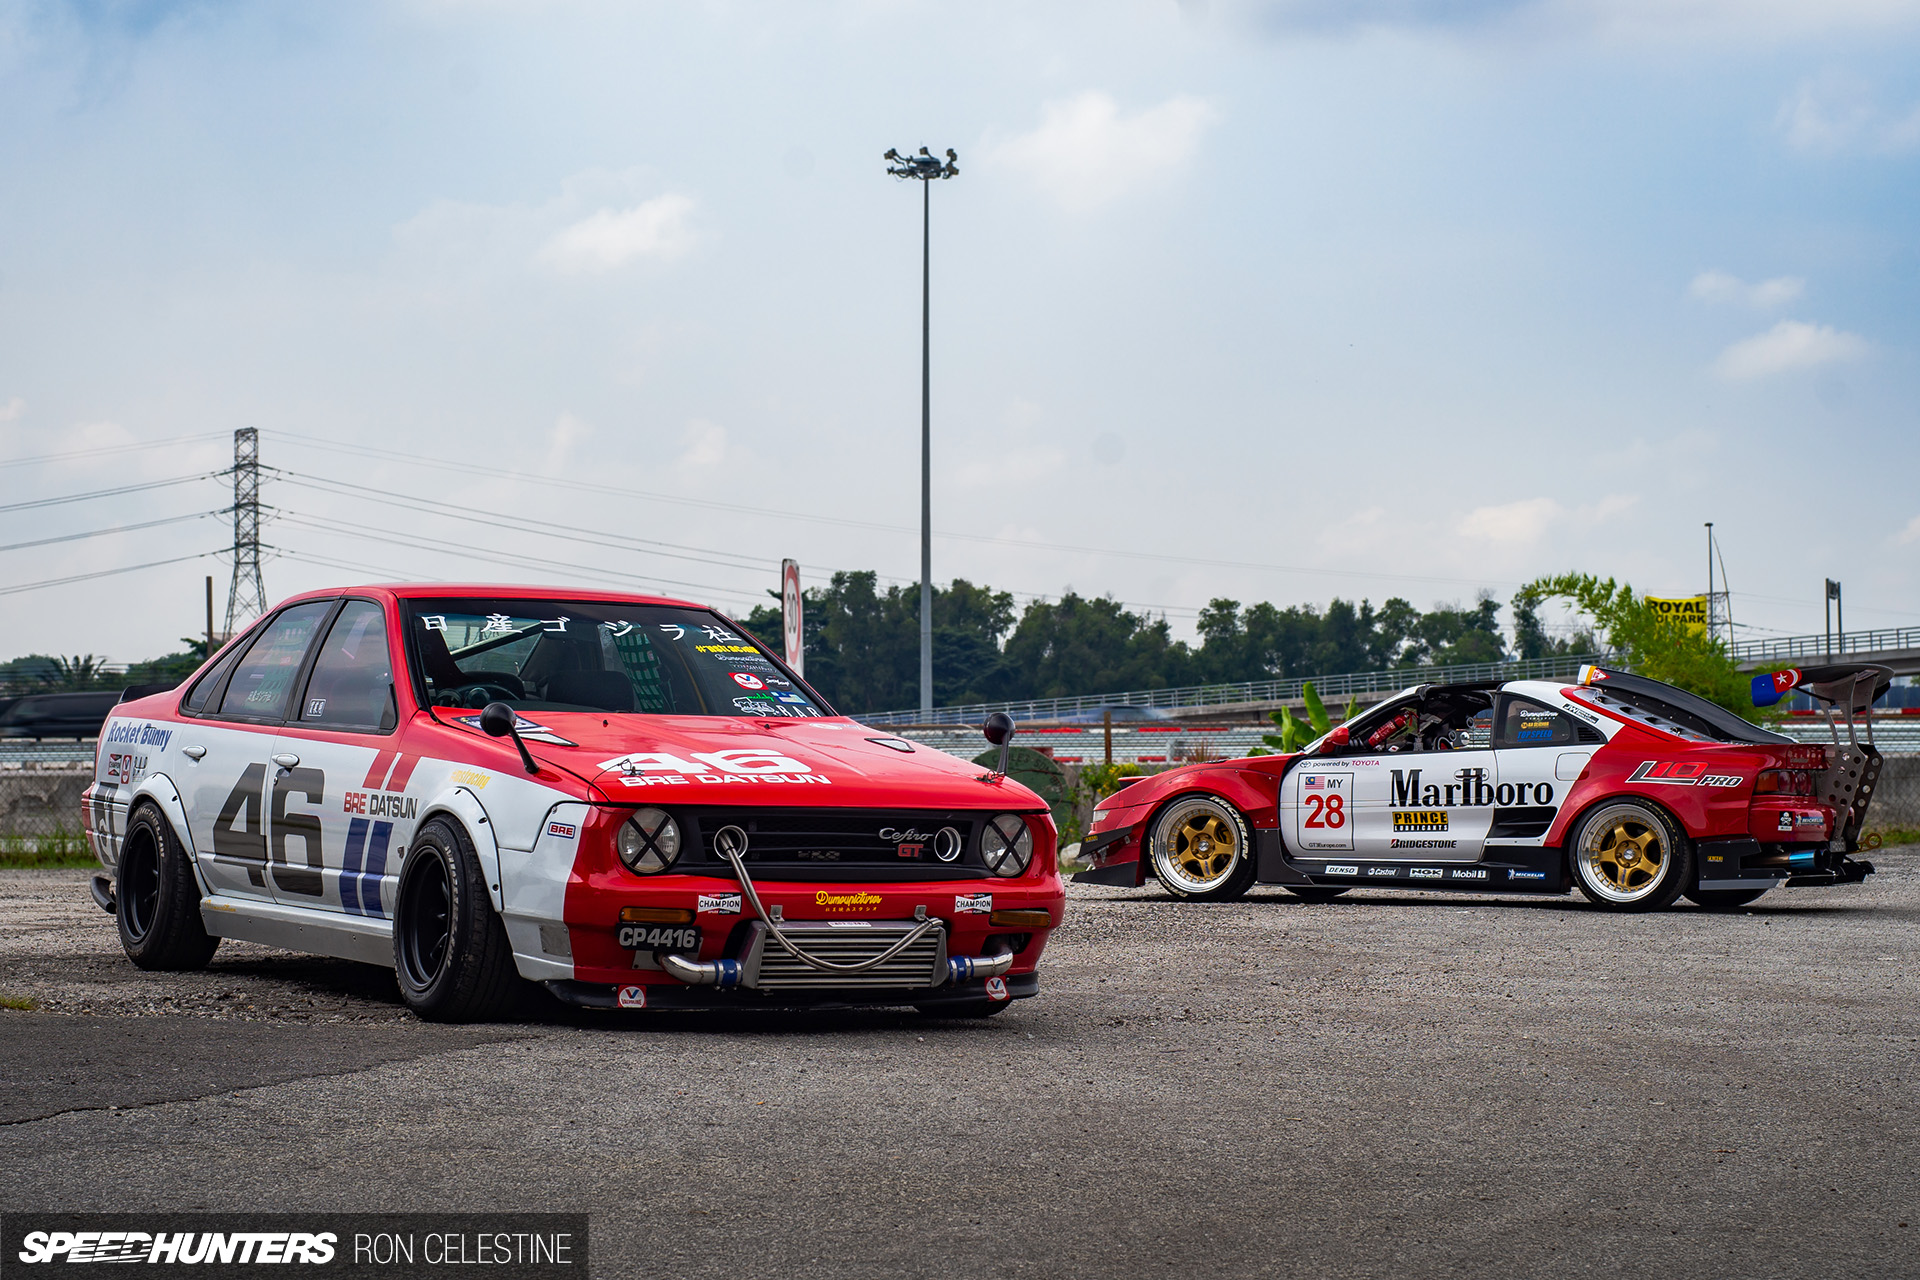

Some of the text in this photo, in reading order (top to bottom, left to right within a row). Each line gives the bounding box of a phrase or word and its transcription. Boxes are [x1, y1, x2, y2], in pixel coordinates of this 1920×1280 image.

[1650, 601, 1705, 613] ROYAL
[1673, 615, 1706, 623] PARK
[421, 612, 742, 643] 日産ゴジラ社
[107, 721, 173, 752] Rocket Bunny
[1530, 730, 1553, 738] SPEED
[596, 749, 812, 774] 46
[618, 774, 832, 787] BRE DATSUN
[1327, 779, 1344, 788] MY
[1697, 775, 1744, 788] PRO
[1389, 768, 1553, 807] Marlboro
[344, 792, 418, 819] BRE DATSUN
[1304, 794, 1346, 829] 28
[1395, 812, 1448, 824] PRINCE
[213, 763, 325, 897] 46
[550, 824, 574, 836] BRE
[1211, 796, 1249, 860] MICHELIN
[879, 828, 934, 843] Cefiro
[898, 843, 924, 857] GT
[1391, 839, 1457, 848] BRIDGESTONE
[1375, 868, 1397, 876] Castrol
[1452, 870, 1477, 878] Mobil
[699, 900, 740, 908] CHAMPION
[956, 900, 990, 908] CHAMPION
